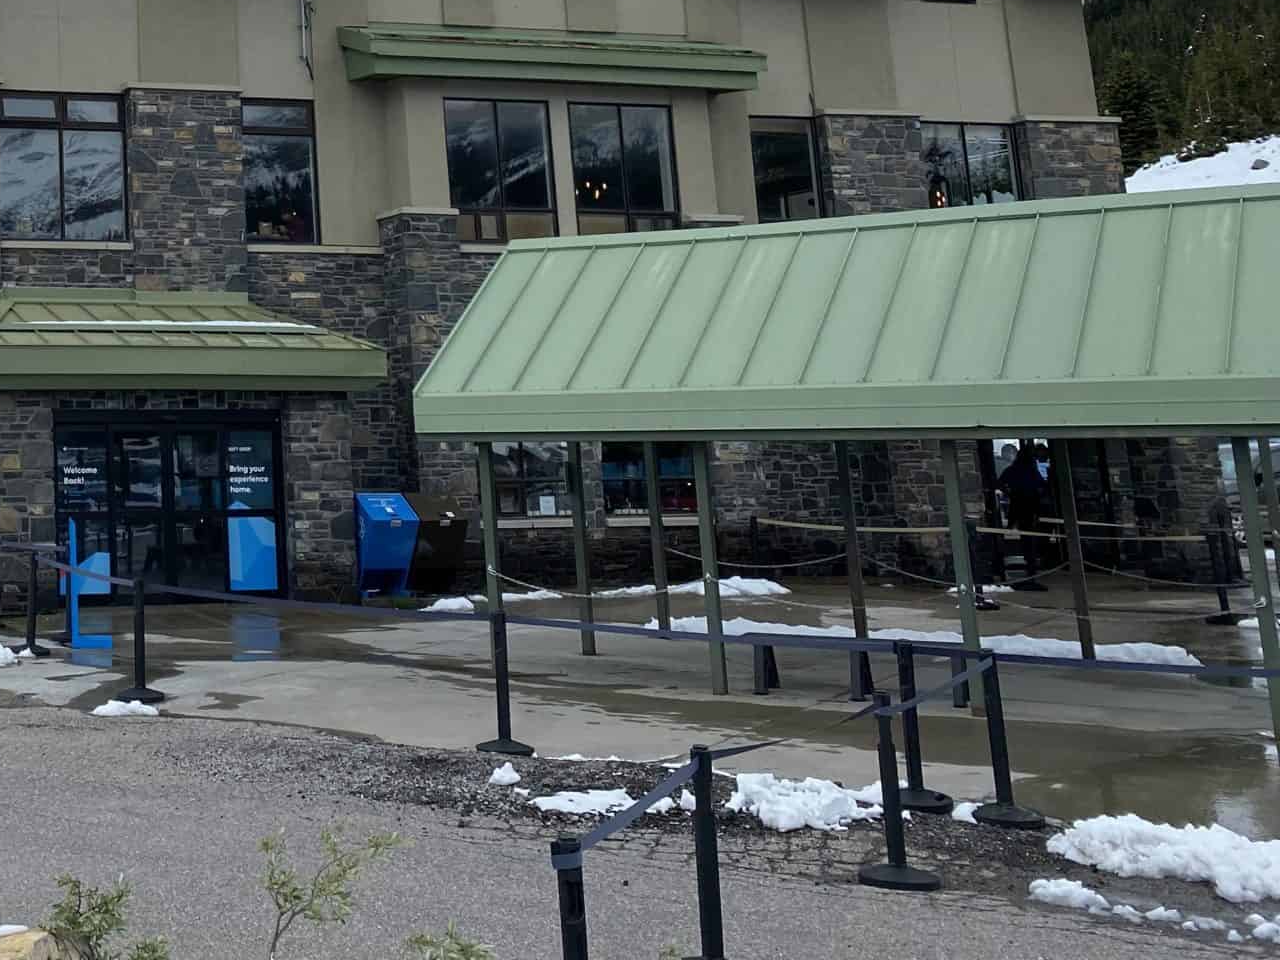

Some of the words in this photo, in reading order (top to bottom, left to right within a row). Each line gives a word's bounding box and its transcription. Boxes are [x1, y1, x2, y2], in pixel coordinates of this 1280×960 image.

[64, 466, 97, 474] Welcome
[229, 465, 248, 474] Bring
[249, 466, 265, 474] your
[229, 476, 268, 484] experience
